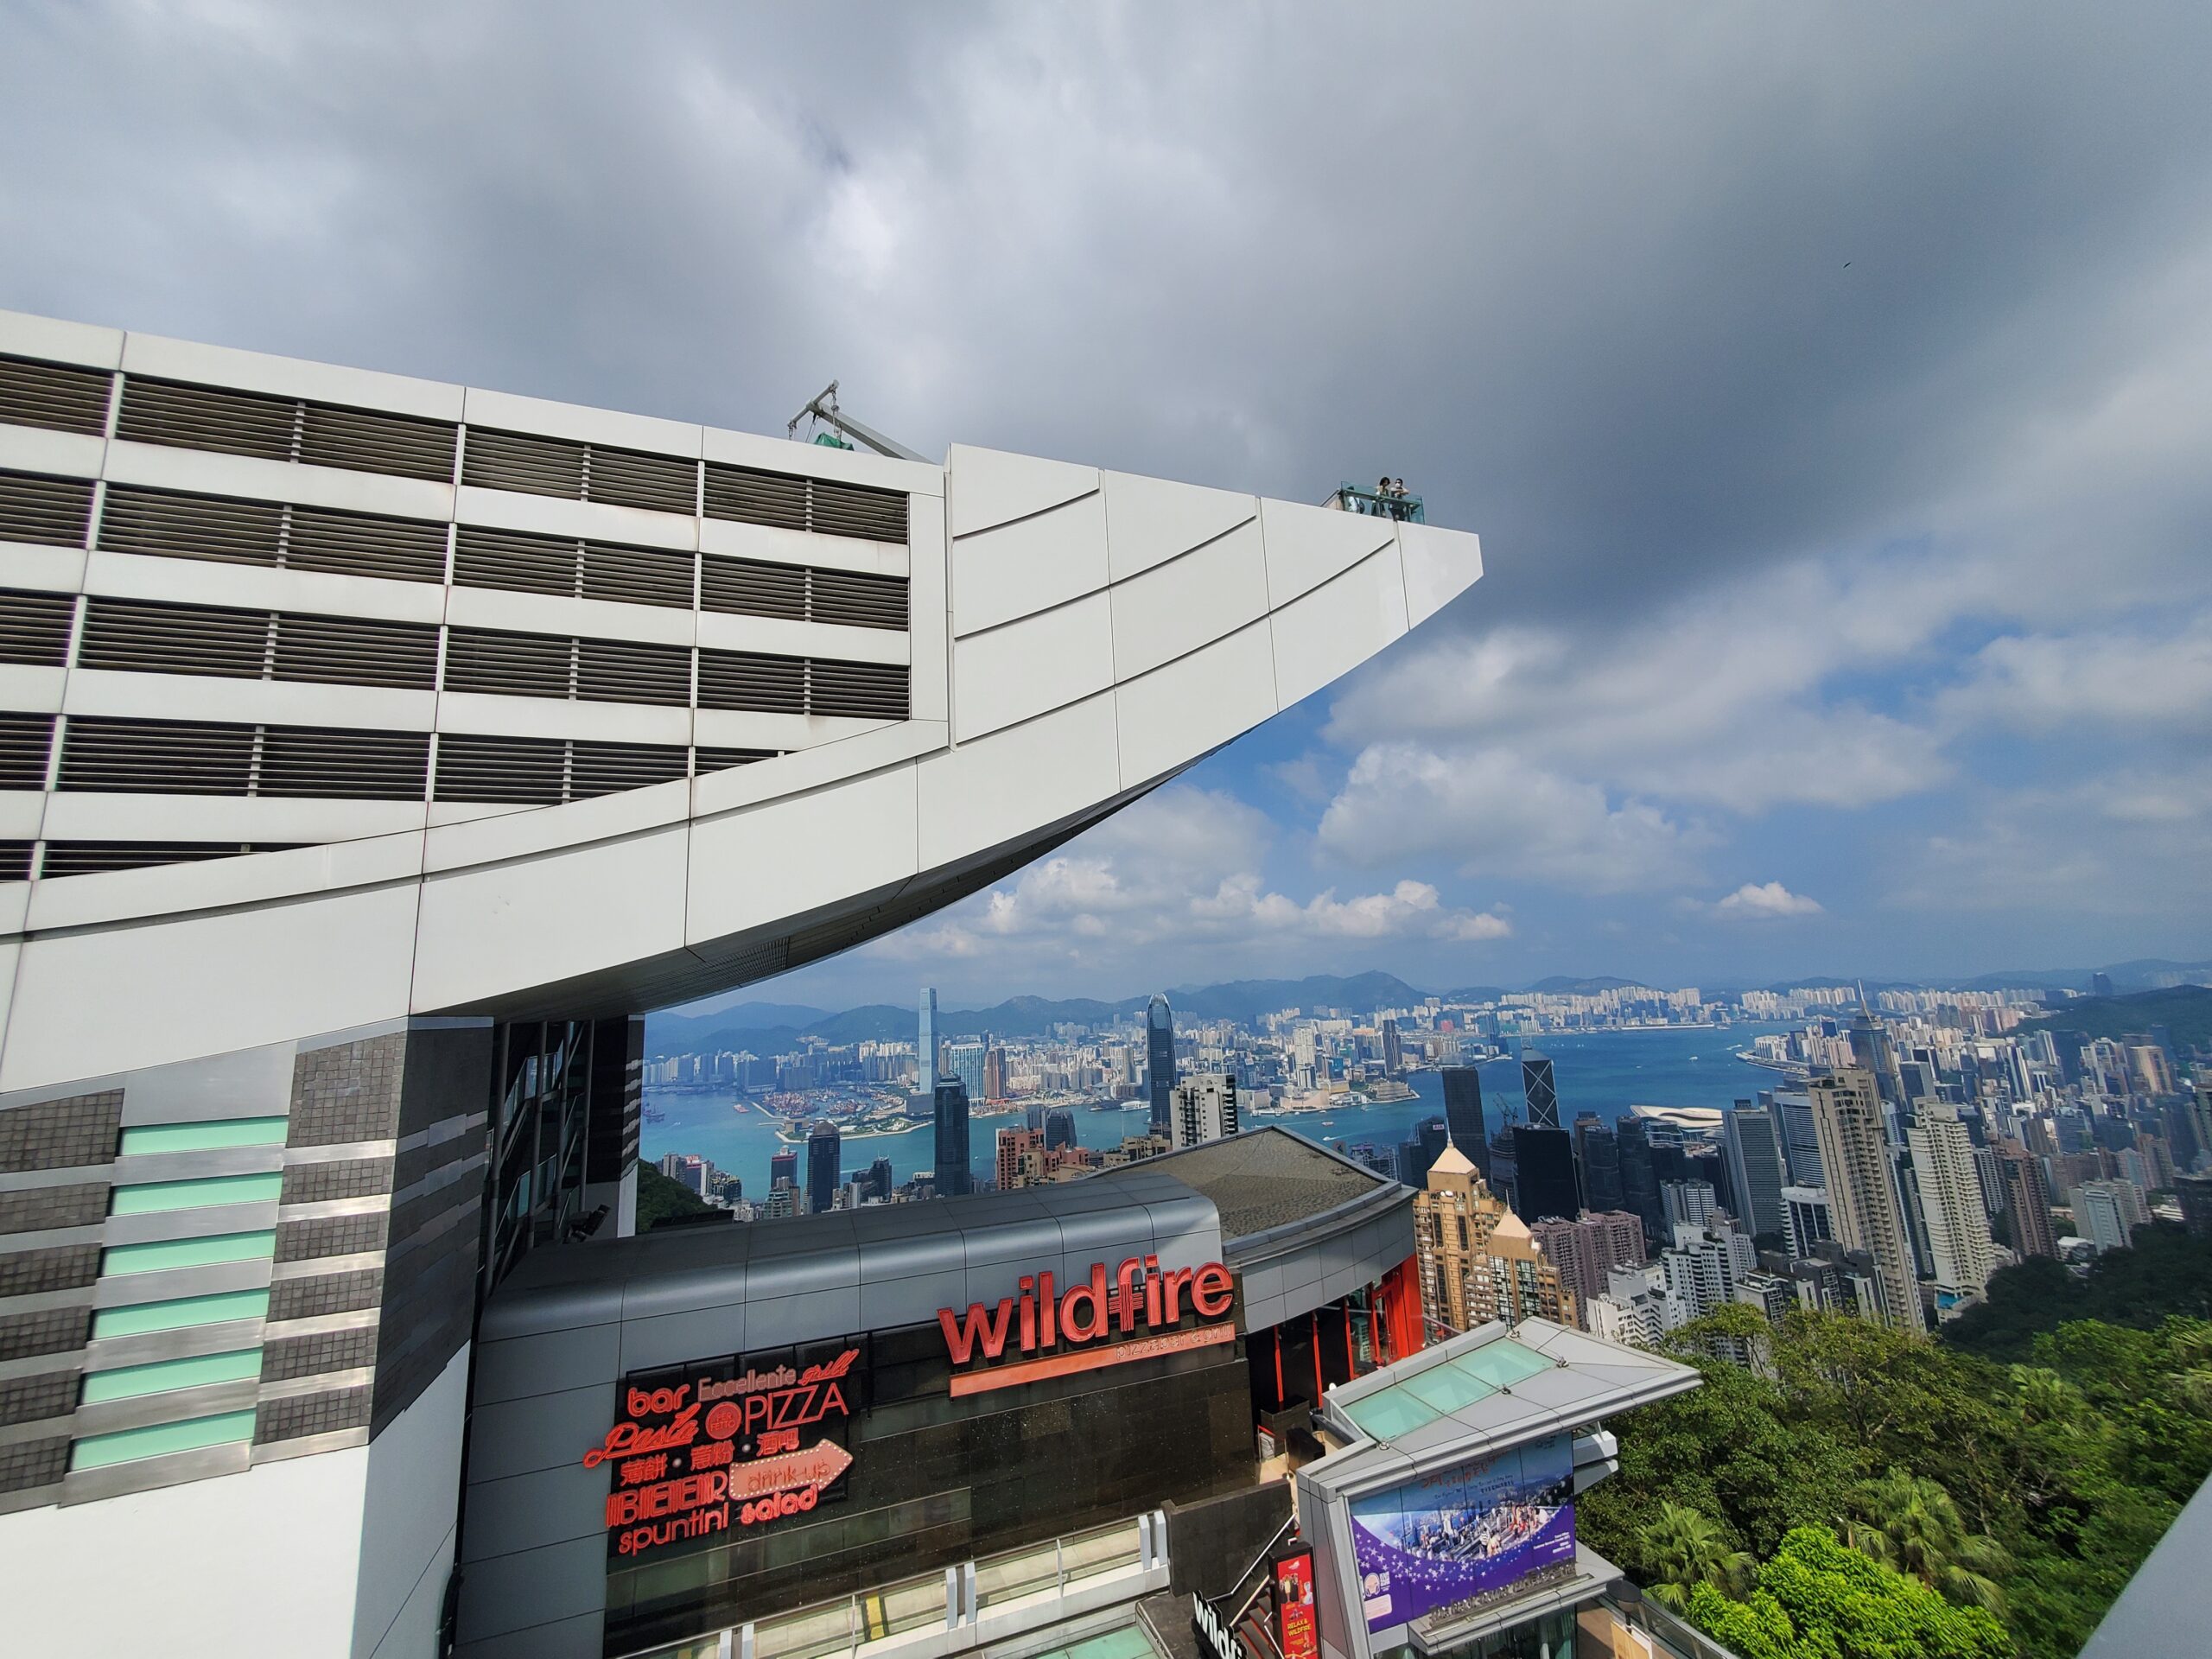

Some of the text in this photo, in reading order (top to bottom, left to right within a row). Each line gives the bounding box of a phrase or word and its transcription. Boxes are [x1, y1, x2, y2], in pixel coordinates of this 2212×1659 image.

[937, 1254, 1234, 1364] wildfire
[1116, 1323, 1232, 1361] pizzabar & grill
[698, 1364, 797, 1402] Eccellente
[798, 1349, 860, 1385] grill
[627, 1384, 690, 1417] bar
[745, 1382, 849, 1434] PIZZA
[582, 1402, 701, 1469] Pasta
[741, 1483, 818, 1526] salad
[619, 1503, 728, 1556] spuntini
